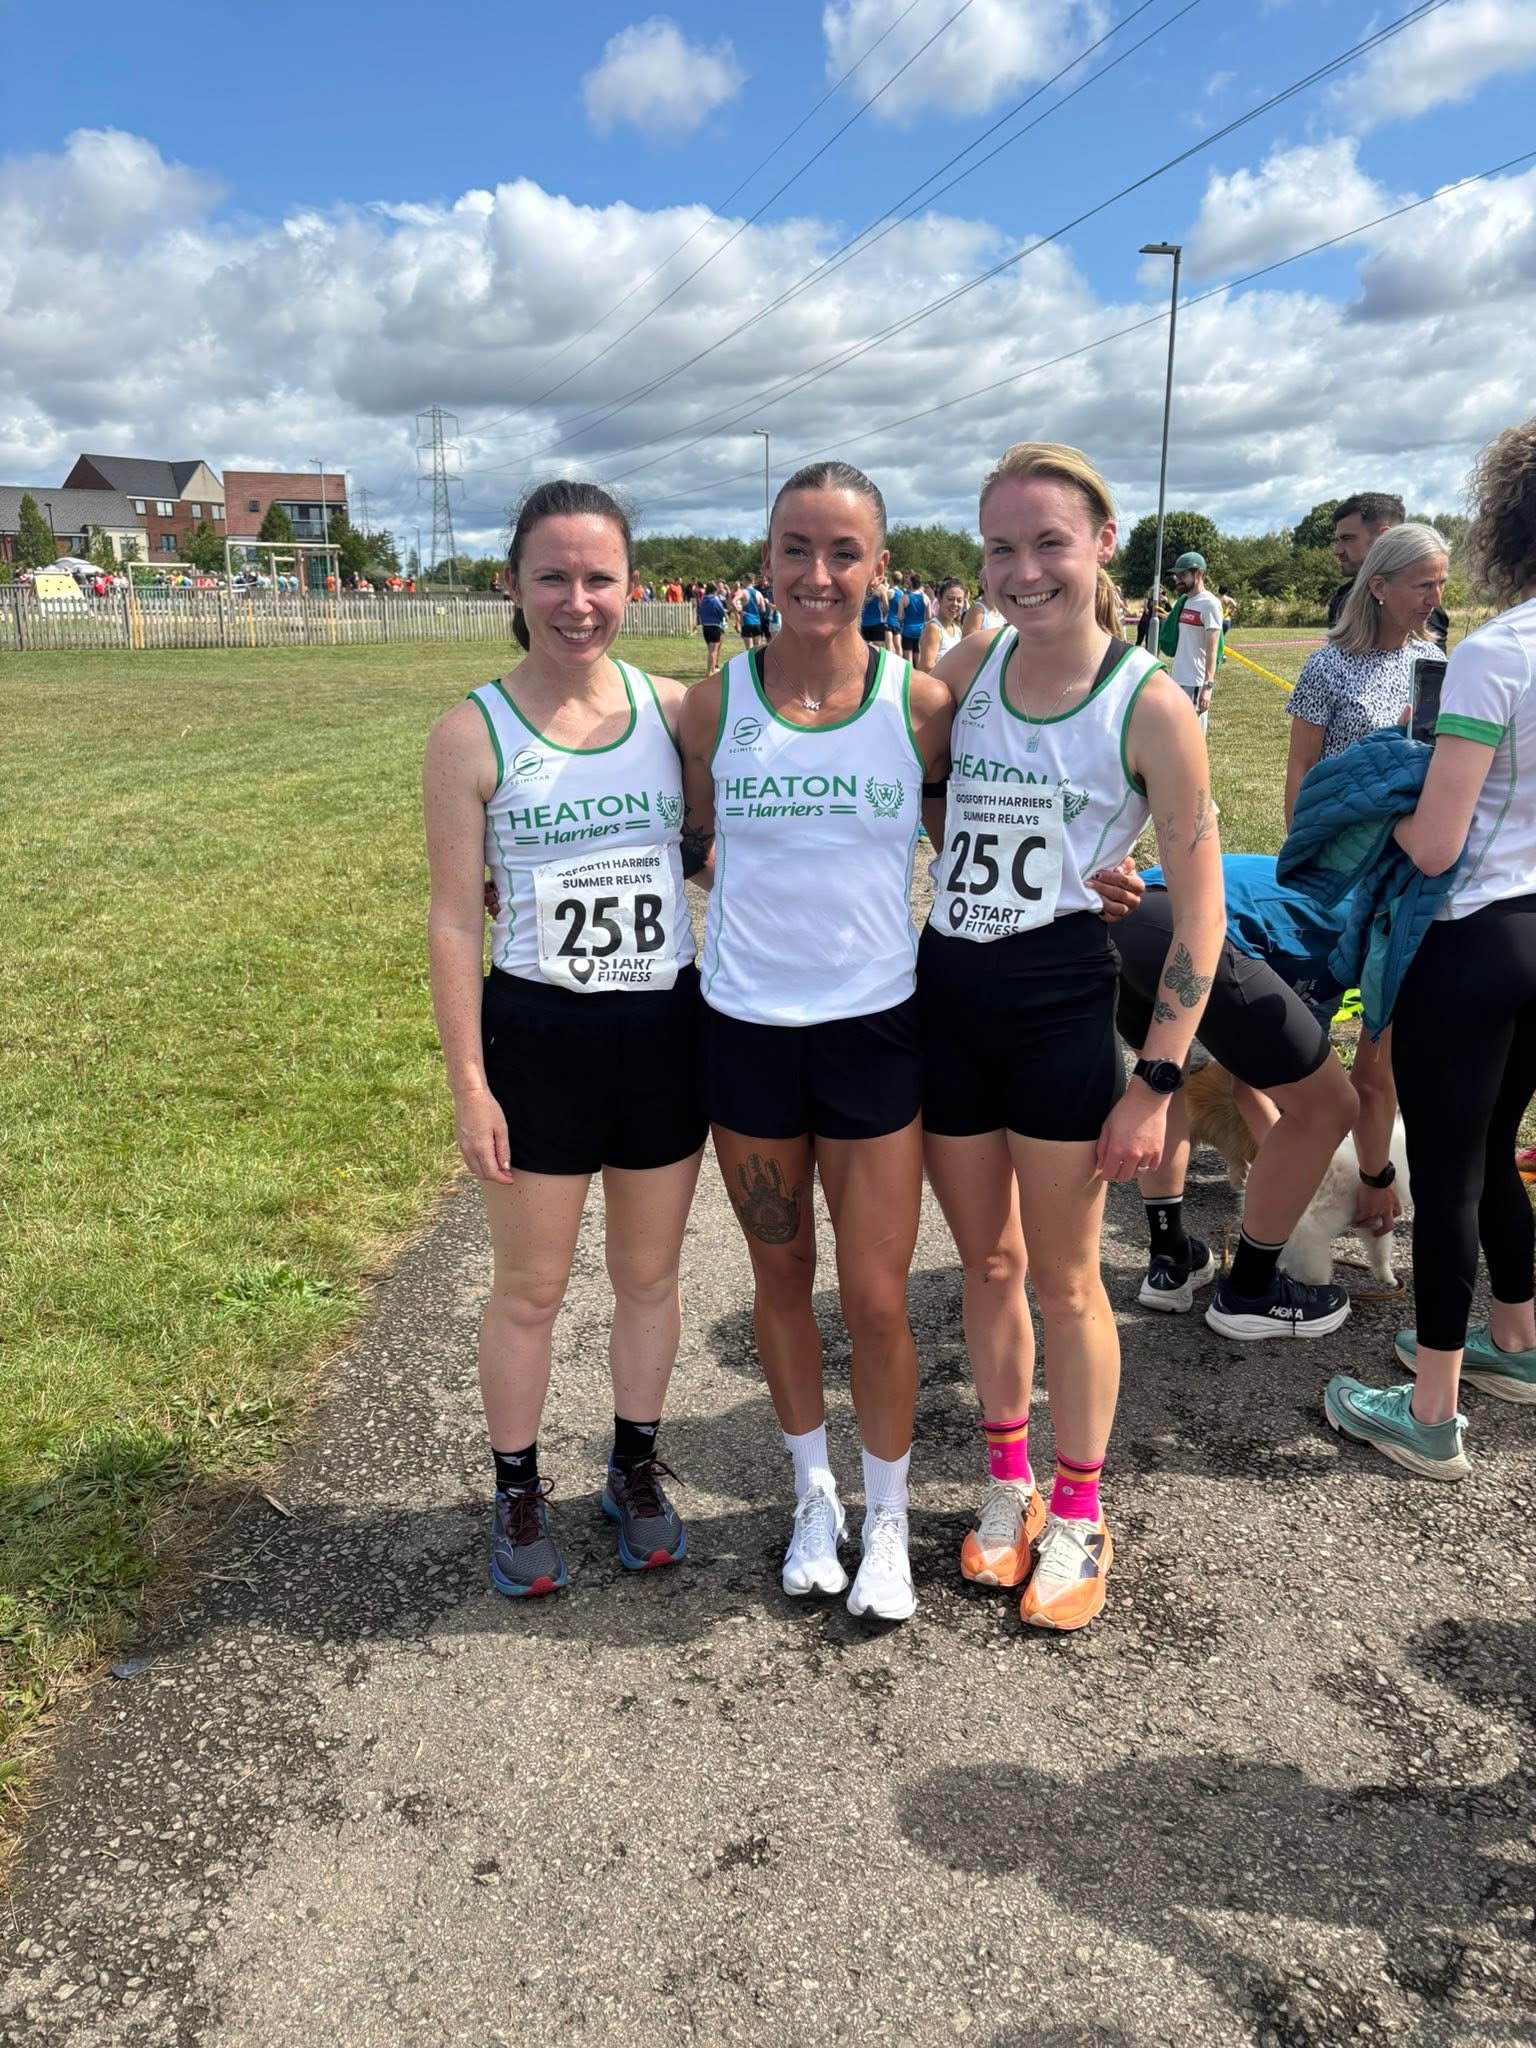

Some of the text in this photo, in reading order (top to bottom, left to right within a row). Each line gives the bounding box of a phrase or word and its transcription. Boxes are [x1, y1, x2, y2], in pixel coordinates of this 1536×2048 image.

[952, 752, 1048, 785] HEATON
[726, 775, 857, 800] HEATON
[956, 793, 1053, 809] GOSFORTH HARRIERS
[508, 791, 650, 830] HEATON
[748, 802, 824, 818] Harriers
[963, 810, 1040, 826] SUMMER RELAYS
[544, 823, 621, 845] Harriers
[612, 857, 661, 871] HARRIERS
[562, 873, 652, 889] SUMMER RELAYS
[969, 904, 1025, 925] START
[965, 920, 1019, 936] FITNESS
[598, 971, 652, 983] FITNESS
